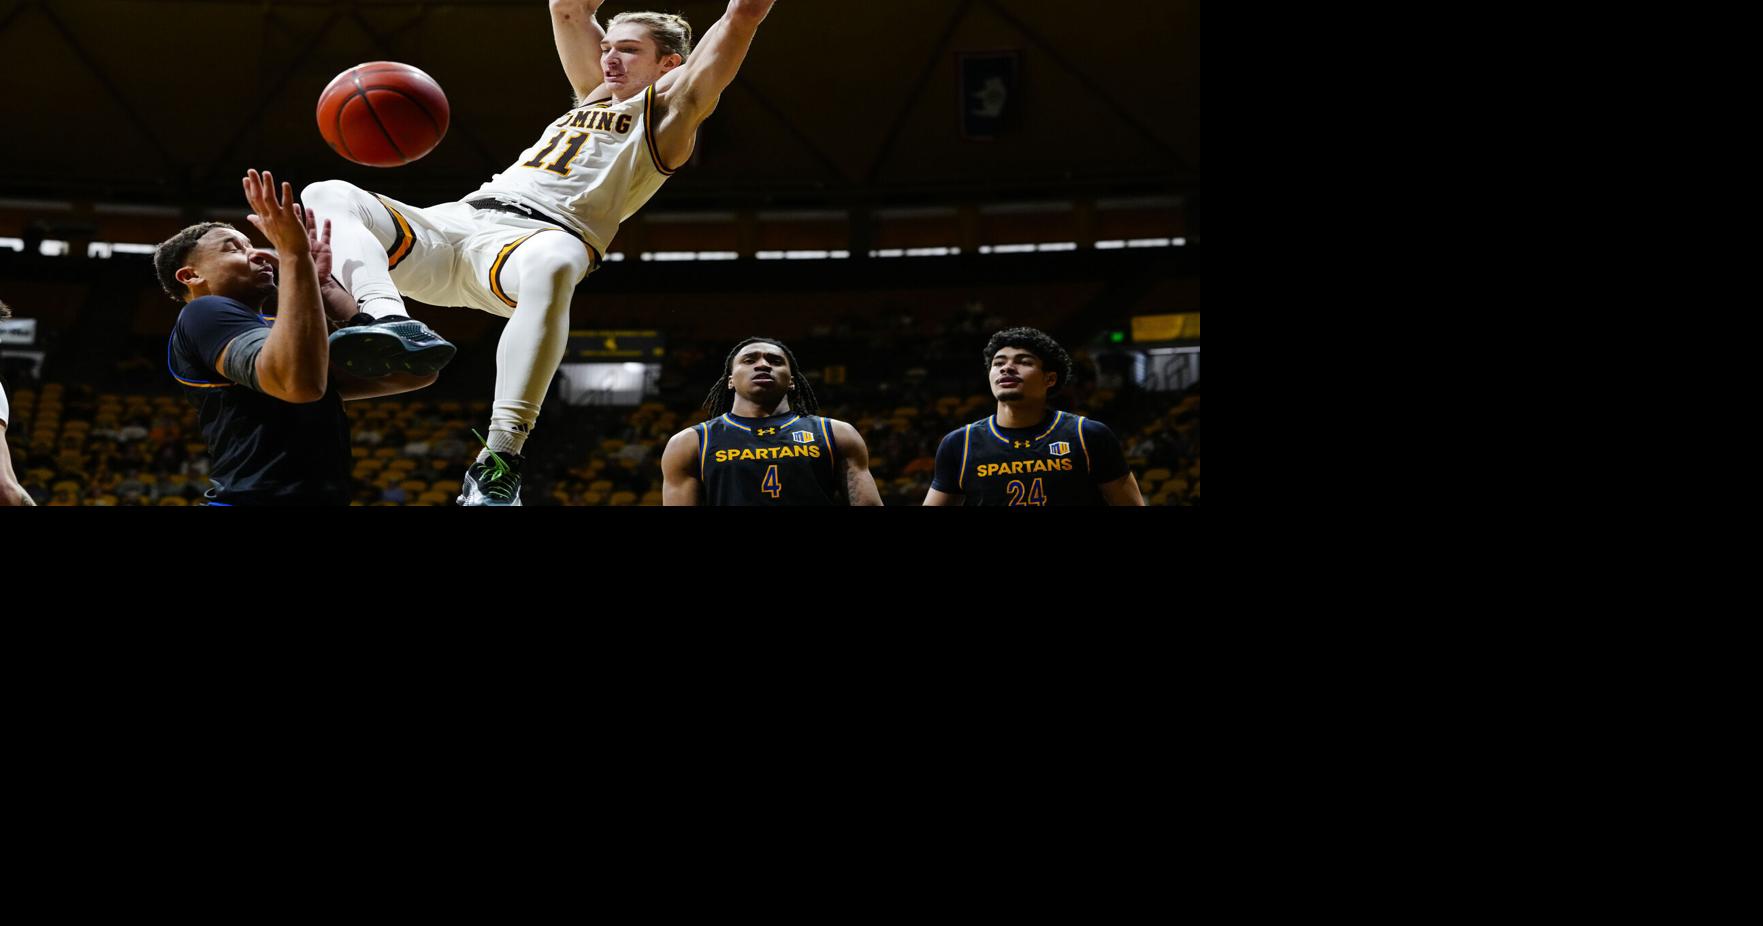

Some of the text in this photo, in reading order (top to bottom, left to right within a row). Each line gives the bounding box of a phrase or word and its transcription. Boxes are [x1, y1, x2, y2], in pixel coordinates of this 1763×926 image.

[523, 130, 589, 176] 11
[715, 445, 821, 463] SPARTANS
[977, 458, 1073, 478] SPARTANS
[762, 464, 782, 499] 4
[1006, 477, 1047, 507] 24
